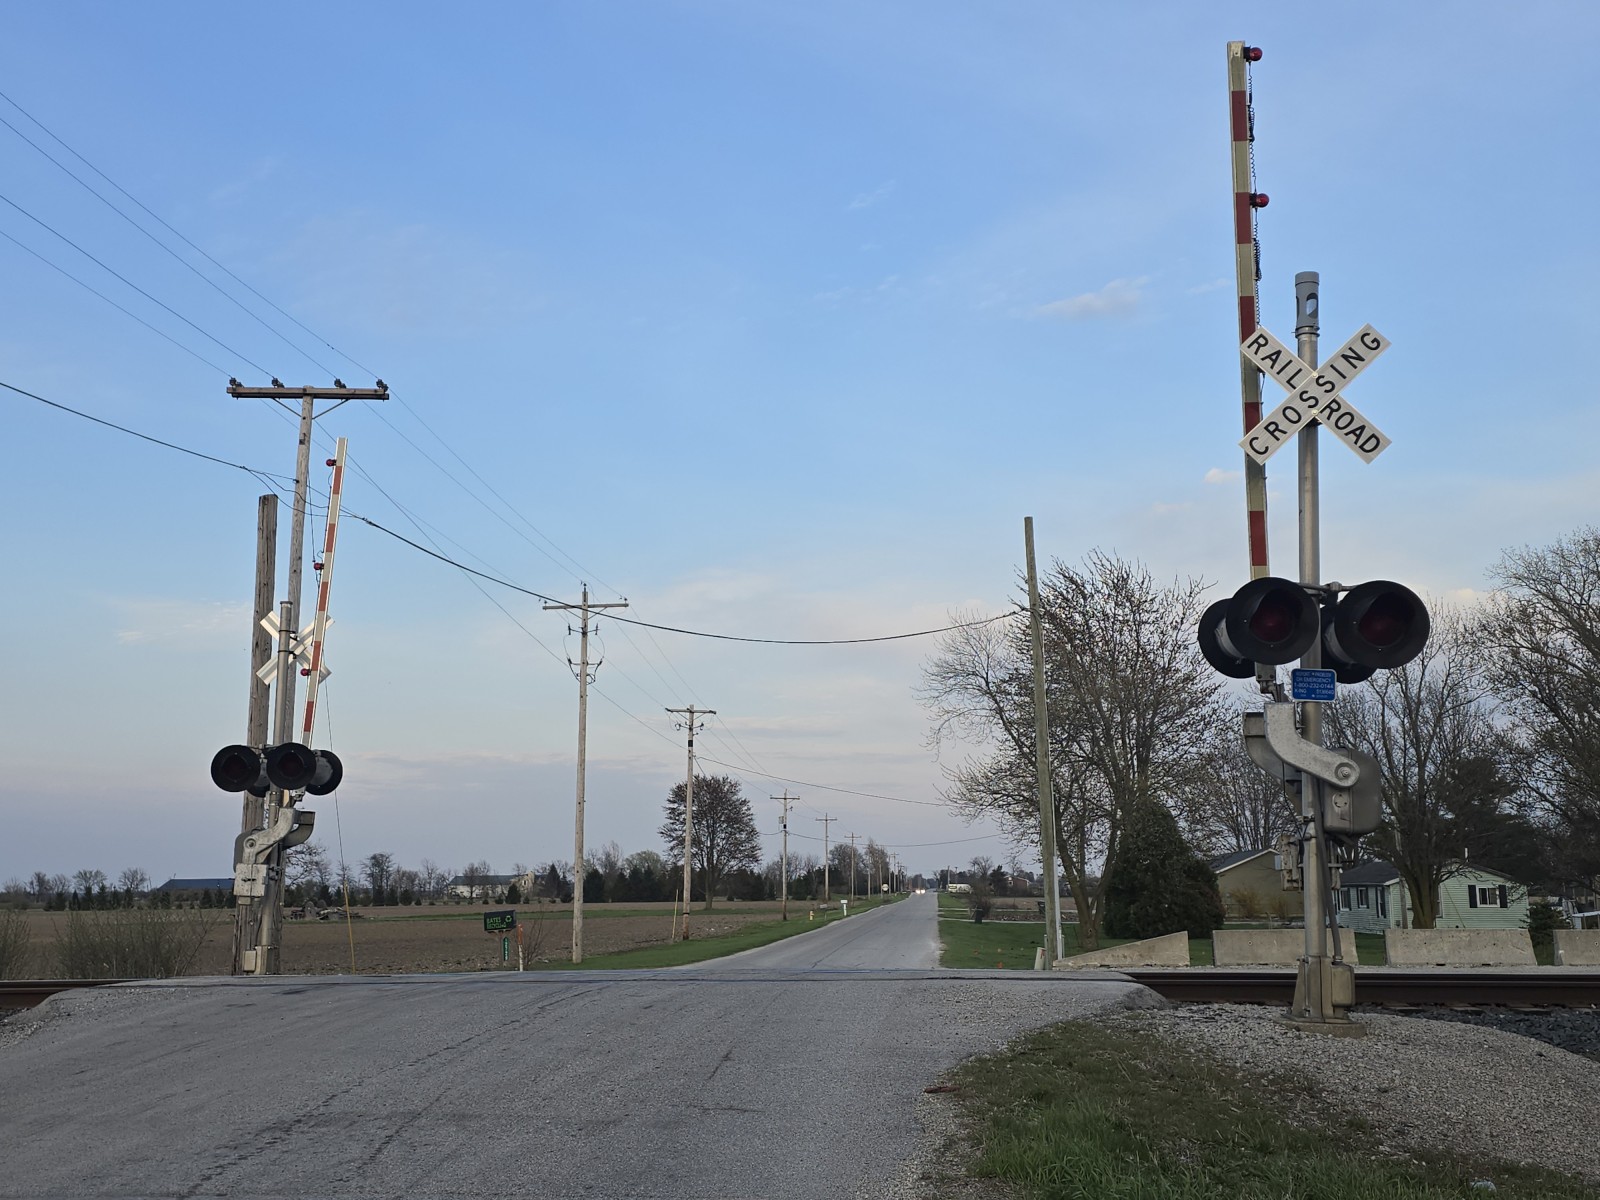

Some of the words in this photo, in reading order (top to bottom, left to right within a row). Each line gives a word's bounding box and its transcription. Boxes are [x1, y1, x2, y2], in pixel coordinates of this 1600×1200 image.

[1247, 333, 1303, 390] RAIL
[1319, 398, 1381, 454] ROAD
[1248, 332, 1381, 456] CROSSING
